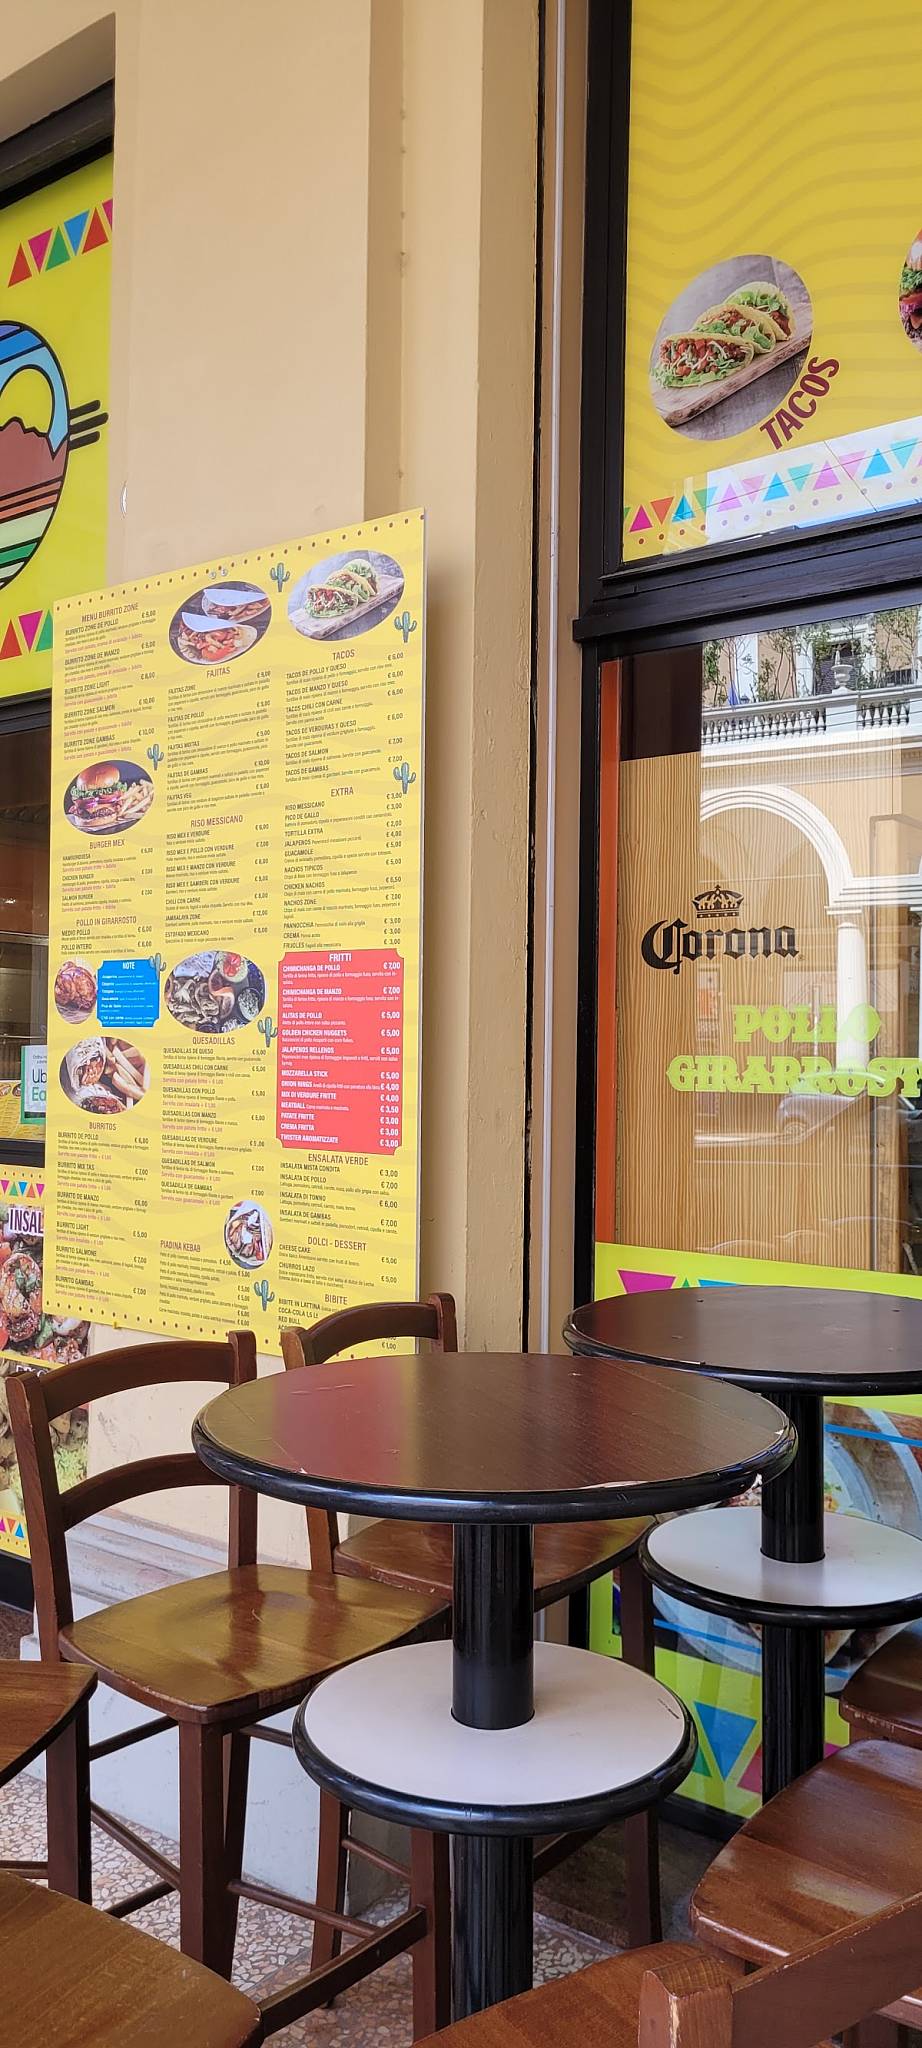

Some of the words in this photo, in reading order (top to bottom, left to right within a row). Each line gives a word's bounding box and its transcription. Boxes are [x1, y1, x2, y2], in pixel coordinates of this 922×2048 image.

[759, 356, 840, 450] TACOS
[99, 606, 123, 619] BURRITO
[123, 603, 139, 613] ZONE
[333, 649, 355, 661] TACOS
[207, 667, 230, 678] FAJITAS
[309, 667, 325, 675] POLLO
[330, 663, 347, 671] QUESO
[309, 684, 326, 692] MANZO
[332, 680, 348, 688] QUESO
[302, 703, 314, 711] CHILI
[309, 724, 334, 732] VERDURAS
[340, 720, 356, 728] QUESO
[308, 748, 328, 756] SALMON
[308, 765, 328, 773] GAMBAS
[331, 787, 354, 797] EXTRA
[297, 801, 325, 809] MESSICANO
[191, 819, 205, 828] RISO
[206, 815, 243, 826] MESSICANO
[285, 829, 307, 837] TORTILLA
[90, 840, 111, 849] BURGER
[284, 849, 314, 857] GUACAMOLE
[76, 919, 93, 927] POLLO
[102, 916, 137, 924] GIRARROSTO
[641, 918, 799, 974] Corona
[329, 953, 352, 962] FRITTI
[733, 1003, 881, 1043] POLLO
[386, 1029, 400, 1037] 5,00
[192, 1037, 235, 1045] QUESADILLAS
[386, 1047, 399, 1055] 5,00
[386, 1072, 399, 1080] 5,00
[89, 1122, 116, 1131] BURRITOS
[308, 1154, 343, 1164] ENSALATA
[345, 1156, 368, 1165] VERDE
[160, 1240, 181, 1250] PIADINA
[183, 1243, 201, 1252] KEBAB
[308, 1237, 328, 1246] DOLCI
[334, 1240, 366, 1251] DESSERT
[279, 1262, 301, 1270] CHURROS
[325, 1294, 348, 1305] BIBITE
[279, 1307, 305, 1316] COCA-COLA
